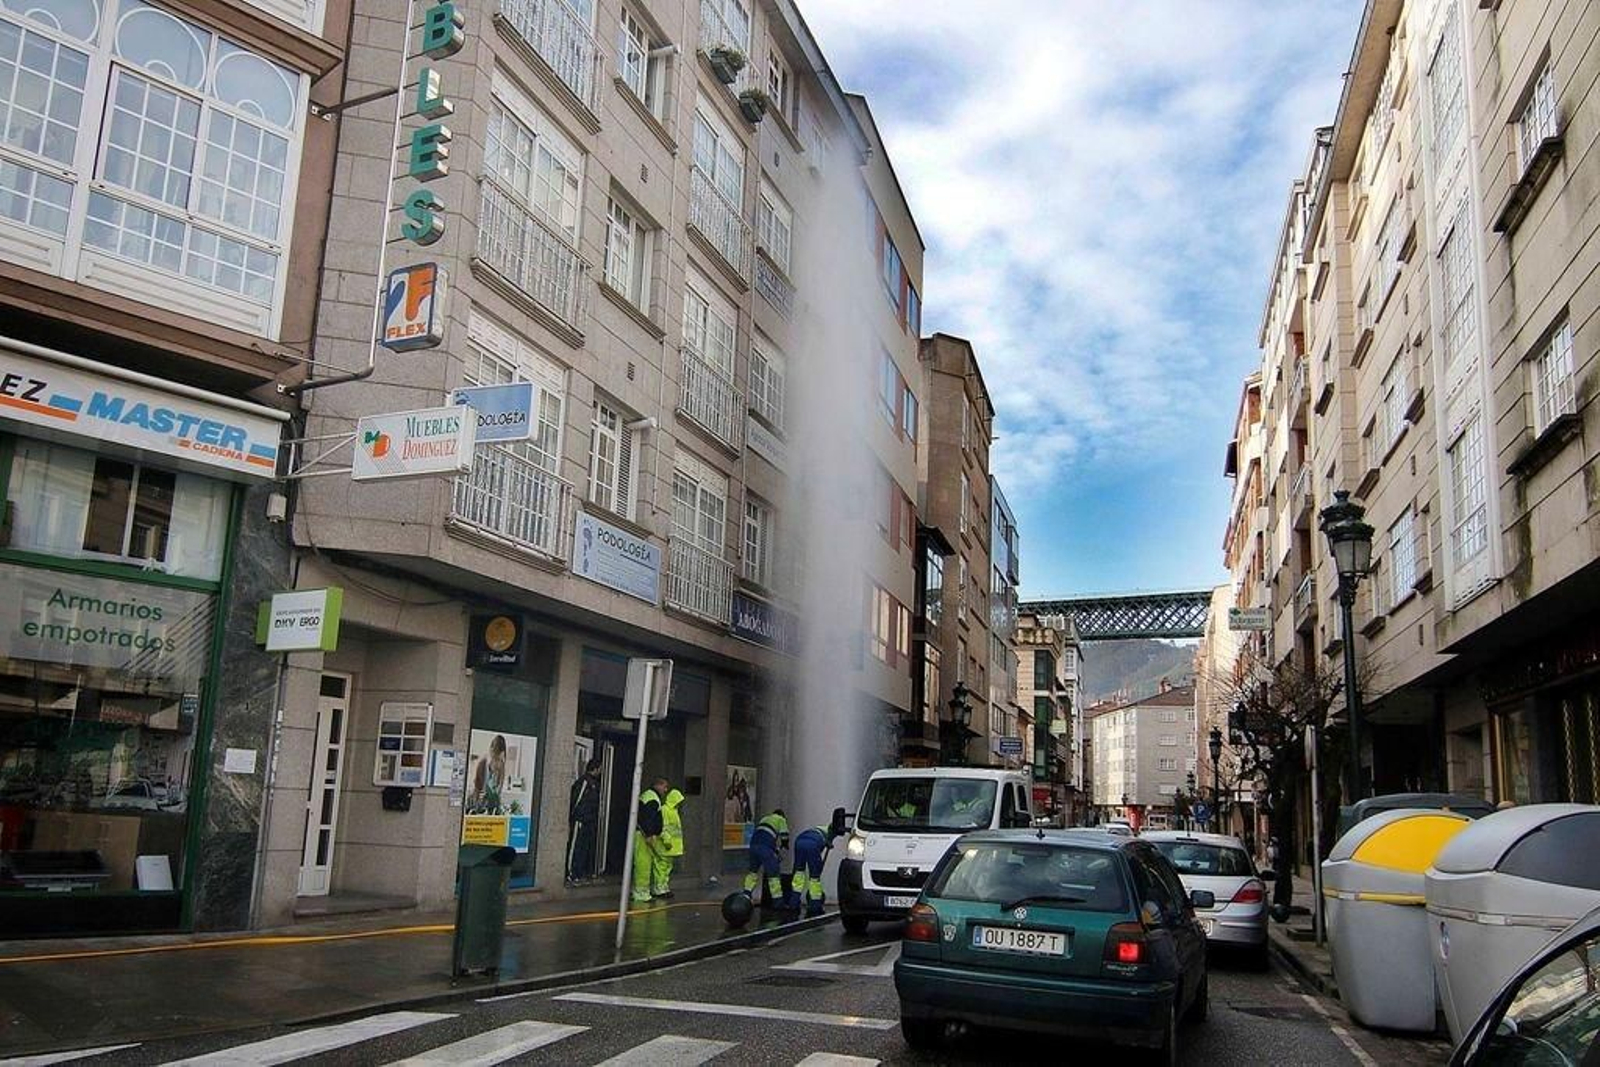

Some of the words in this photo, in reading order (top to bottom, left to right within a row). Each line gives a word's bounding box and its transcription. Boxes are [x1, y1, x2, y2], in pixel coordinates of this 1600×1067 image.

[386, 322, 426, 338] FLEX
[0, 373, 47, 403] EZ
[87, 391, 248, 451] MASTER
[405, 416, 460, 438] MUEBLES
[192, 442, 244, 461] CADENA
[48, 588, 163, 621] Armarios
[23, 621, 176, 652] empotrados
[985, 929, 1004, 945] OU
[1009, 932, 1046, 949] 1887
[1049, 936, 1058, 950] T
